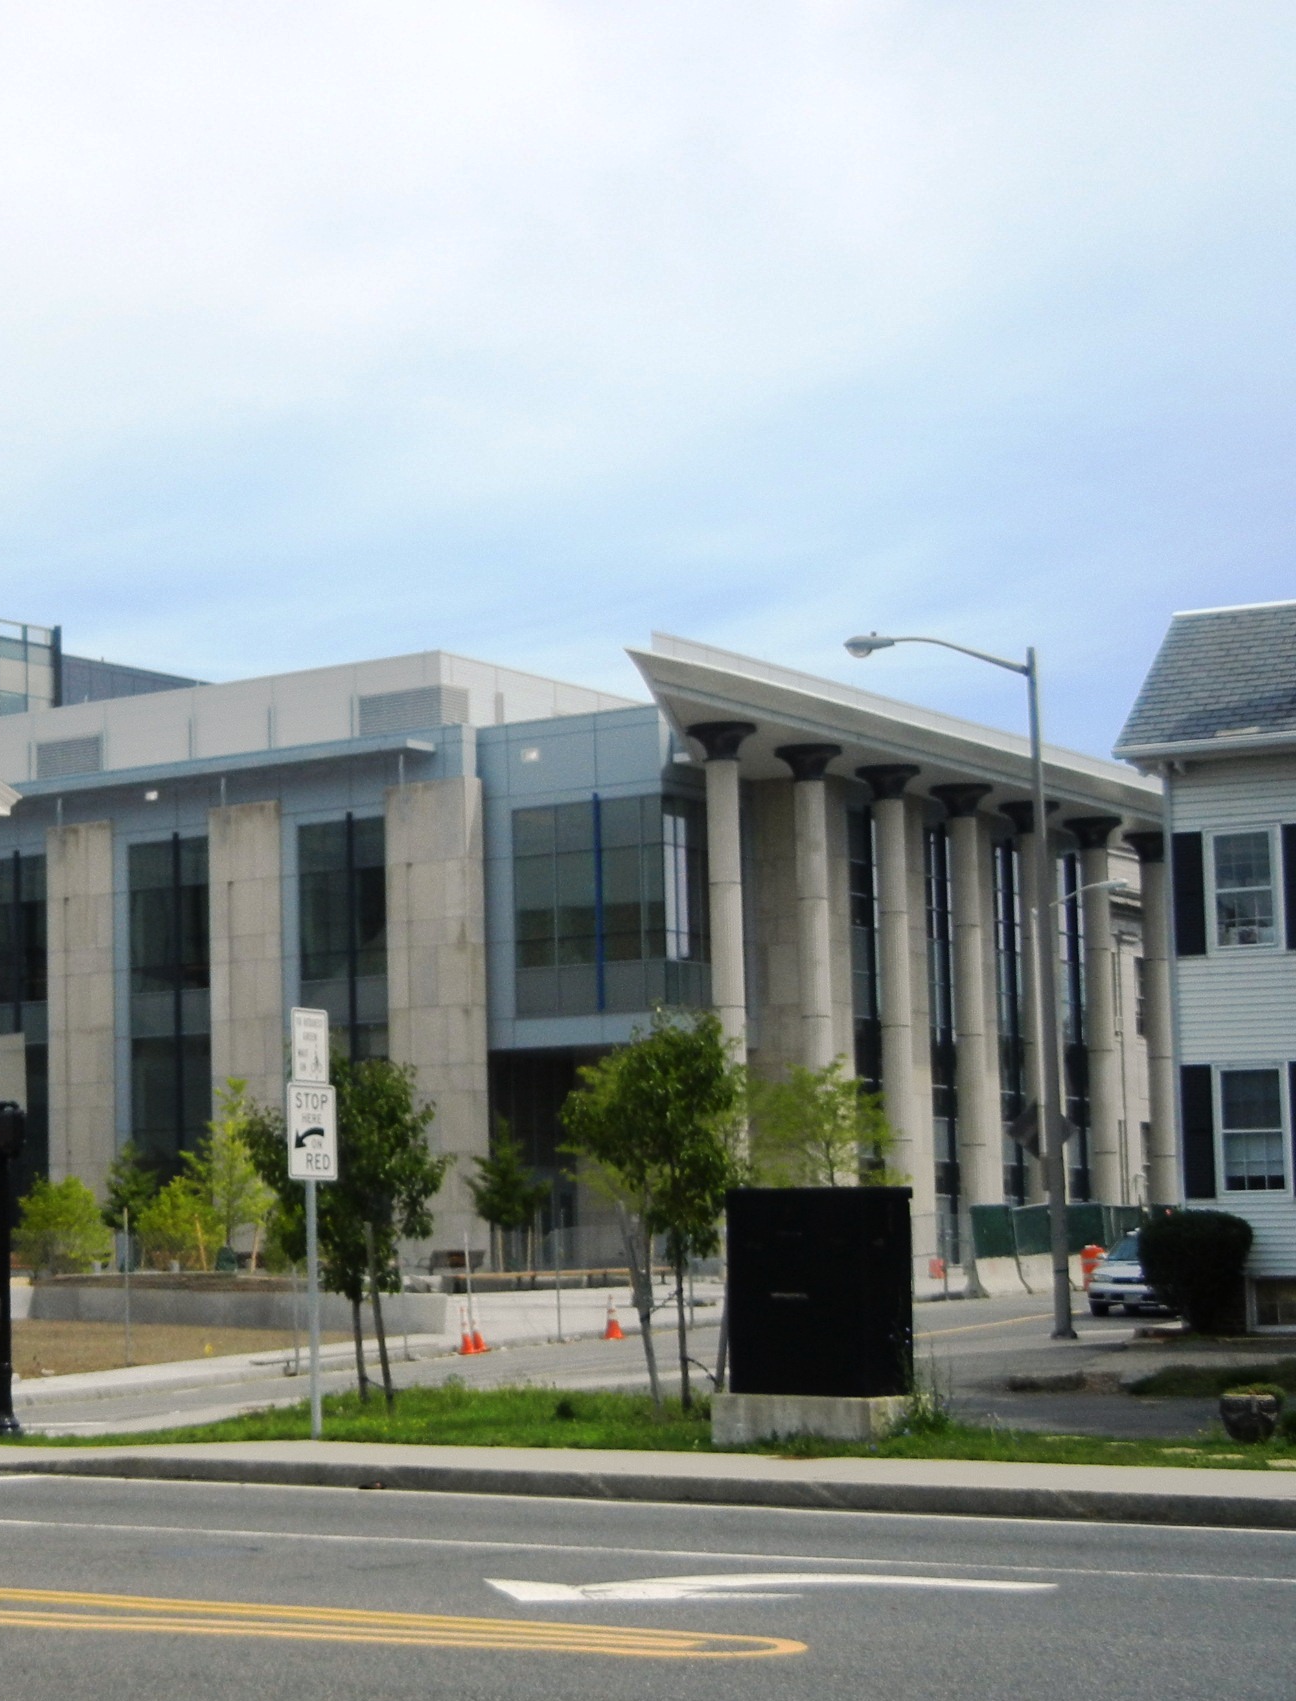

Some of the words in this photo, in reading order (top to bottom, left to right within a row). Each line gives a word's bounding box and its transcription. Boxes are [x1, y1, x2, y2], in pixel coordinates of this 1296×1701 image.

[295, 1092, 328, 1110] STOP
[302, 1113, 322, 1124] HERE
[311, 1138, 323, 1149] ON
[305, 1153, 331, 1170] RED
